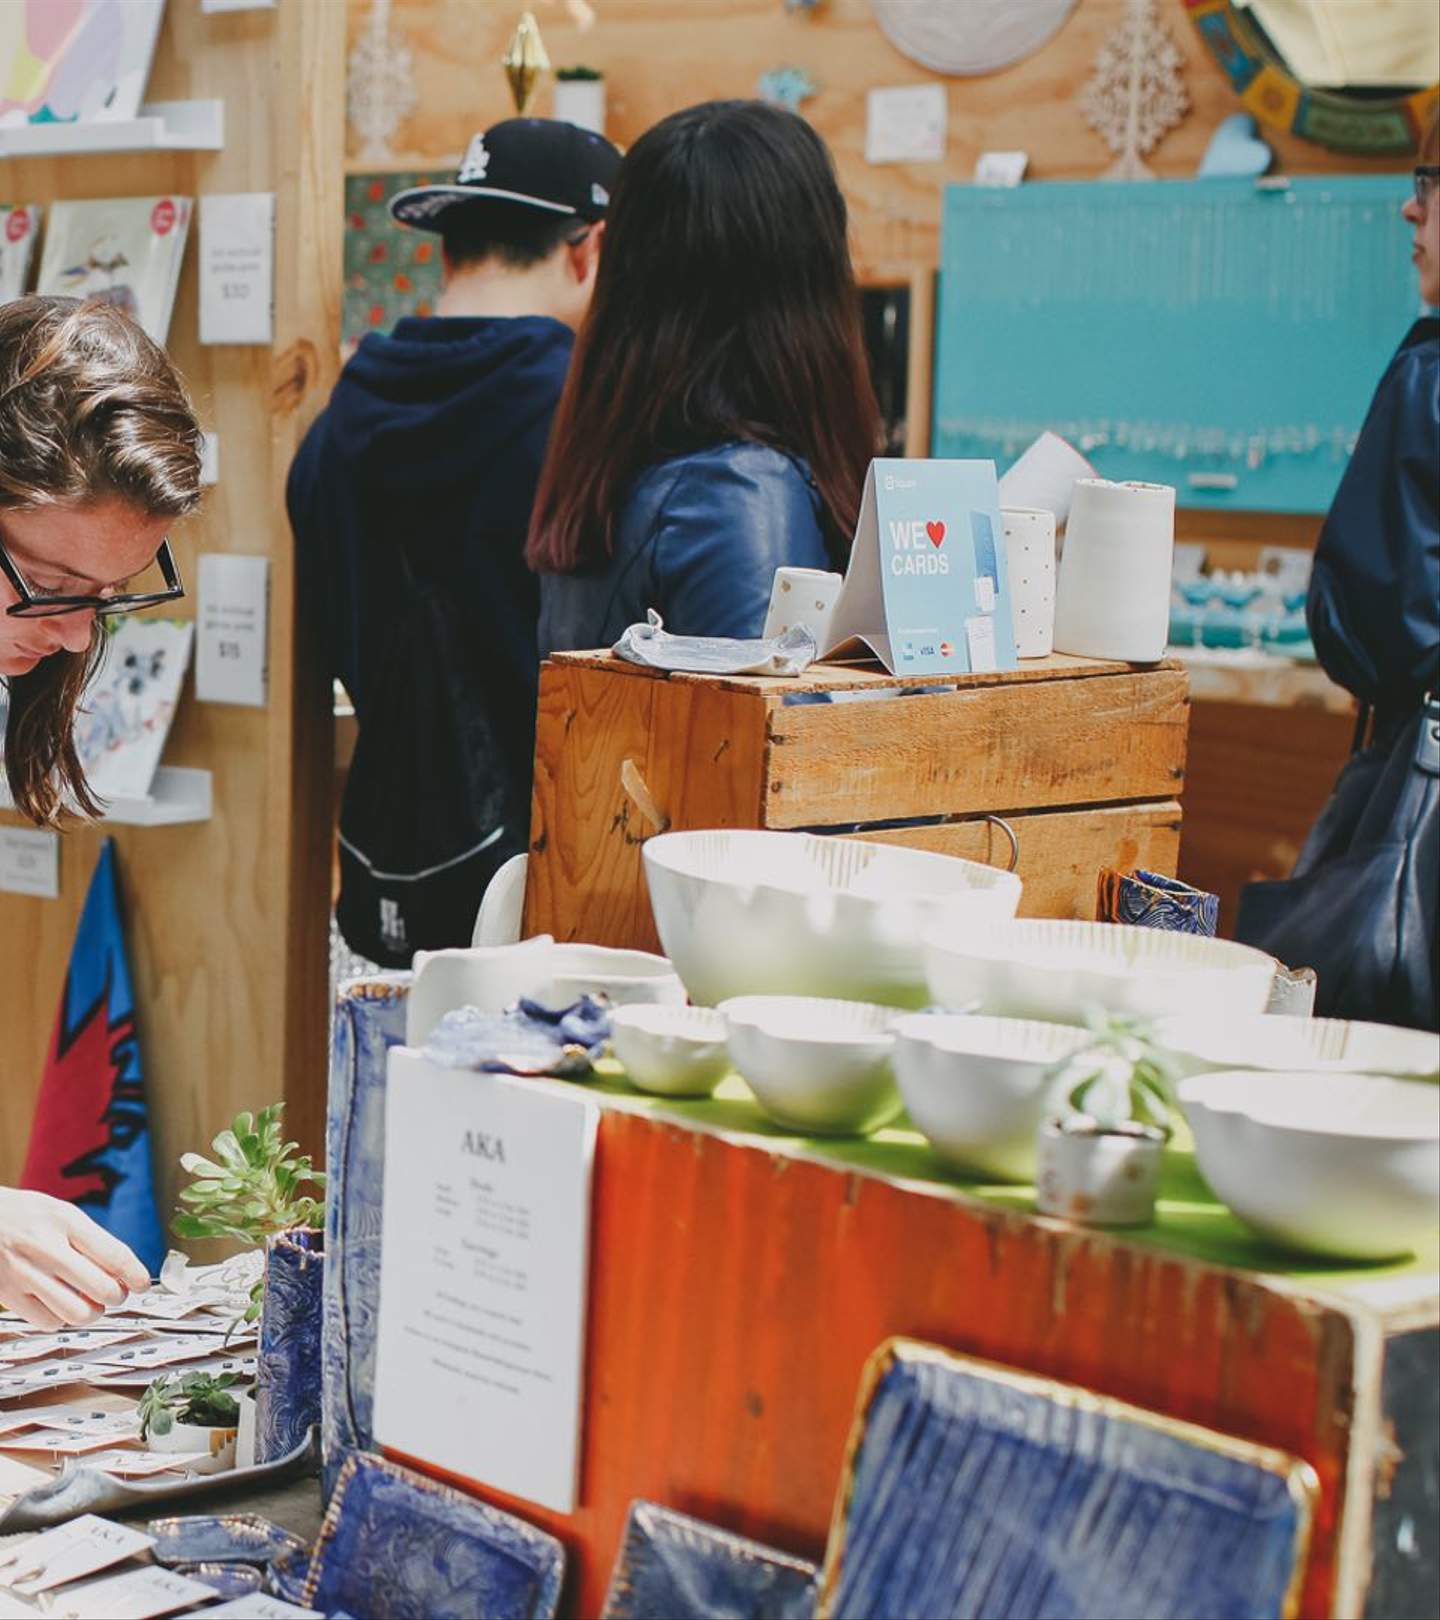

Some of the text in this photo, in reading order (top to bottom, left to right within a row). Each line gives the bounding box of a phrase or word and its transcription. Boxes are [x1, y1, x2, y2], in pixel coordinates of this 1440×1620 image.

[888, 520, 927, 550] WE
[891, 553, 950, 576] CARDS
[461, 1129, 506, 1164] AKA
